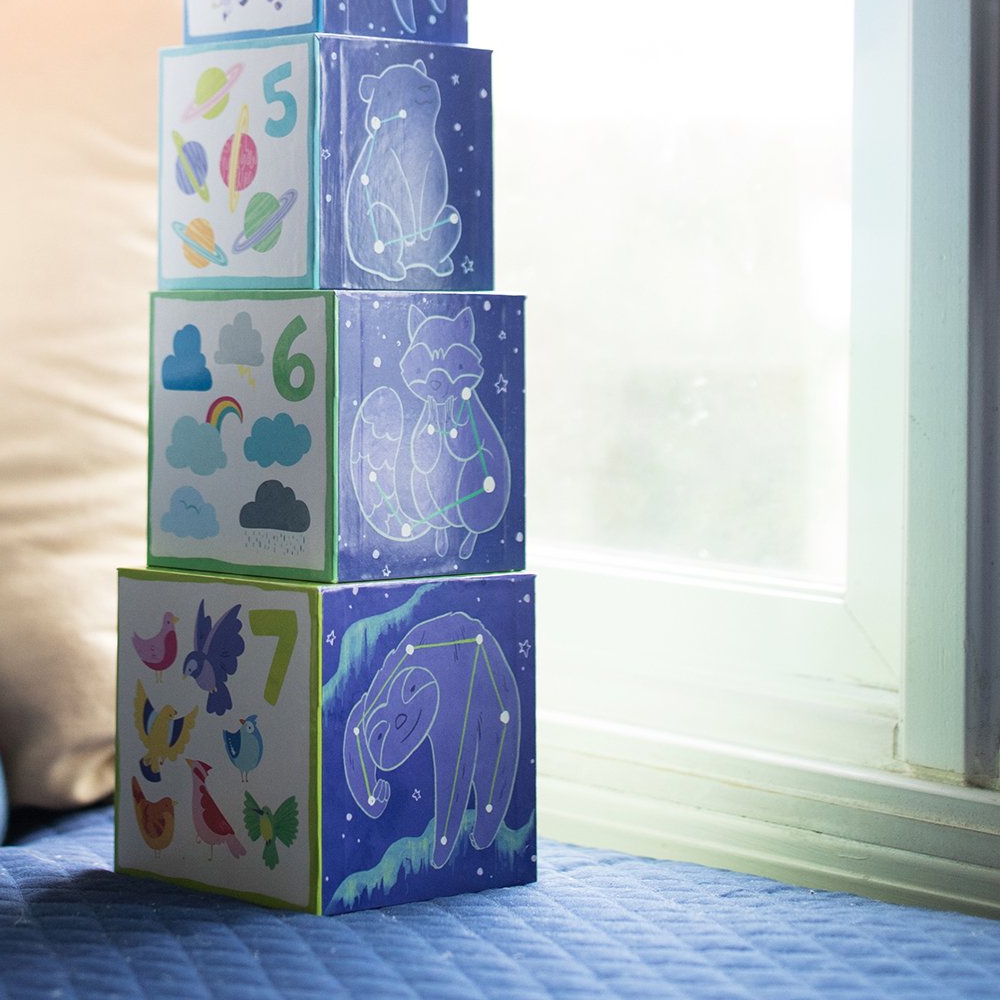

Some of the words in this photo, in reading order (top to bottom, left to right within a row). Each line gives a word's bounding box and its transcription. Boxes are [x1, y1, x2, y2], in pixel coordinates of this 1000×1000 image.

[262, 61, 298, 138] 5
[272, 314, 316, 402] 6
[248, 609, 298, 706] 7
